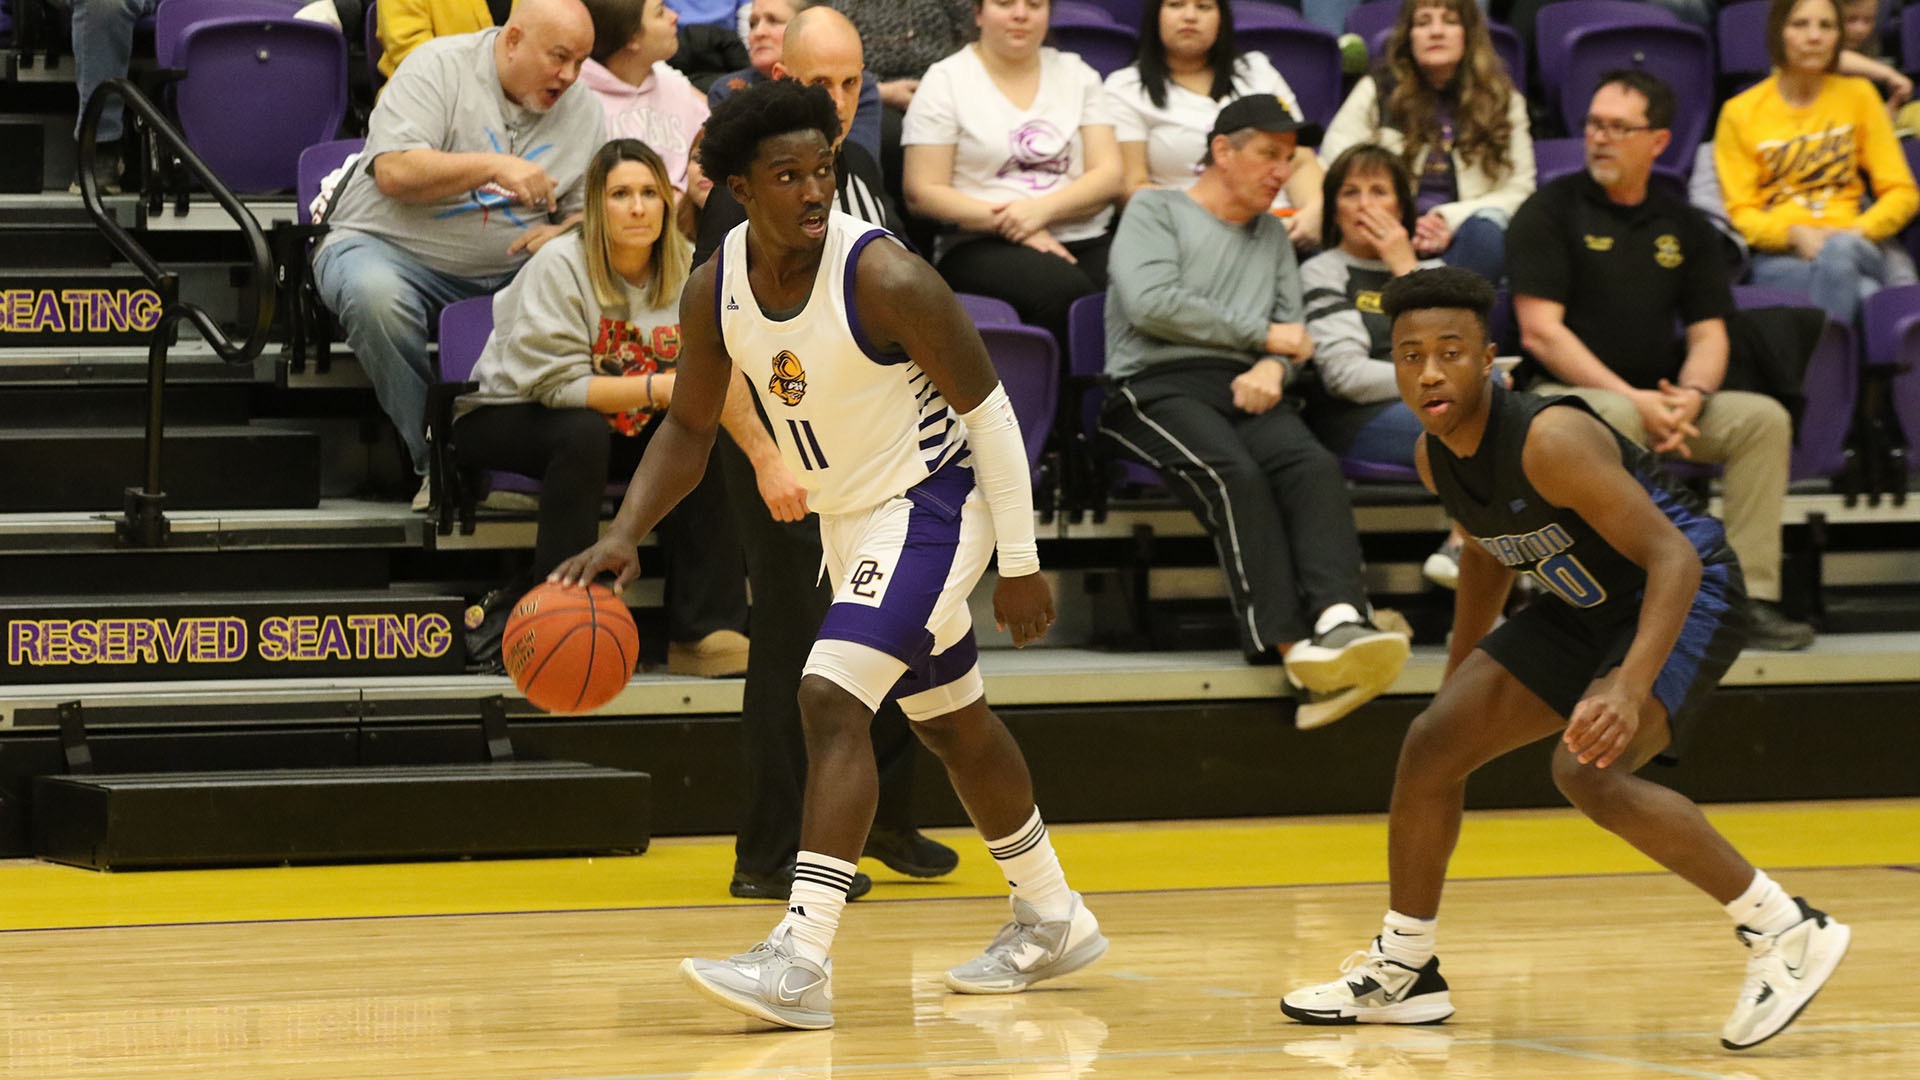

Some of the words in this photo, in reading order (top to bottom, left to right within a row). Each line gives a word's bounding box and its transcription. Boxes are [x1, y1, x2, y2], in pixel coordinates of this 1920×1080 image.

[0, 288, 163, 332] EATING
[785, 418, 830, 471] 11
[1470, 523, 1575, 566] ARTON
[8, 617, 248, 665] RESERVED
[258, 613, 453, 661] SEATING
